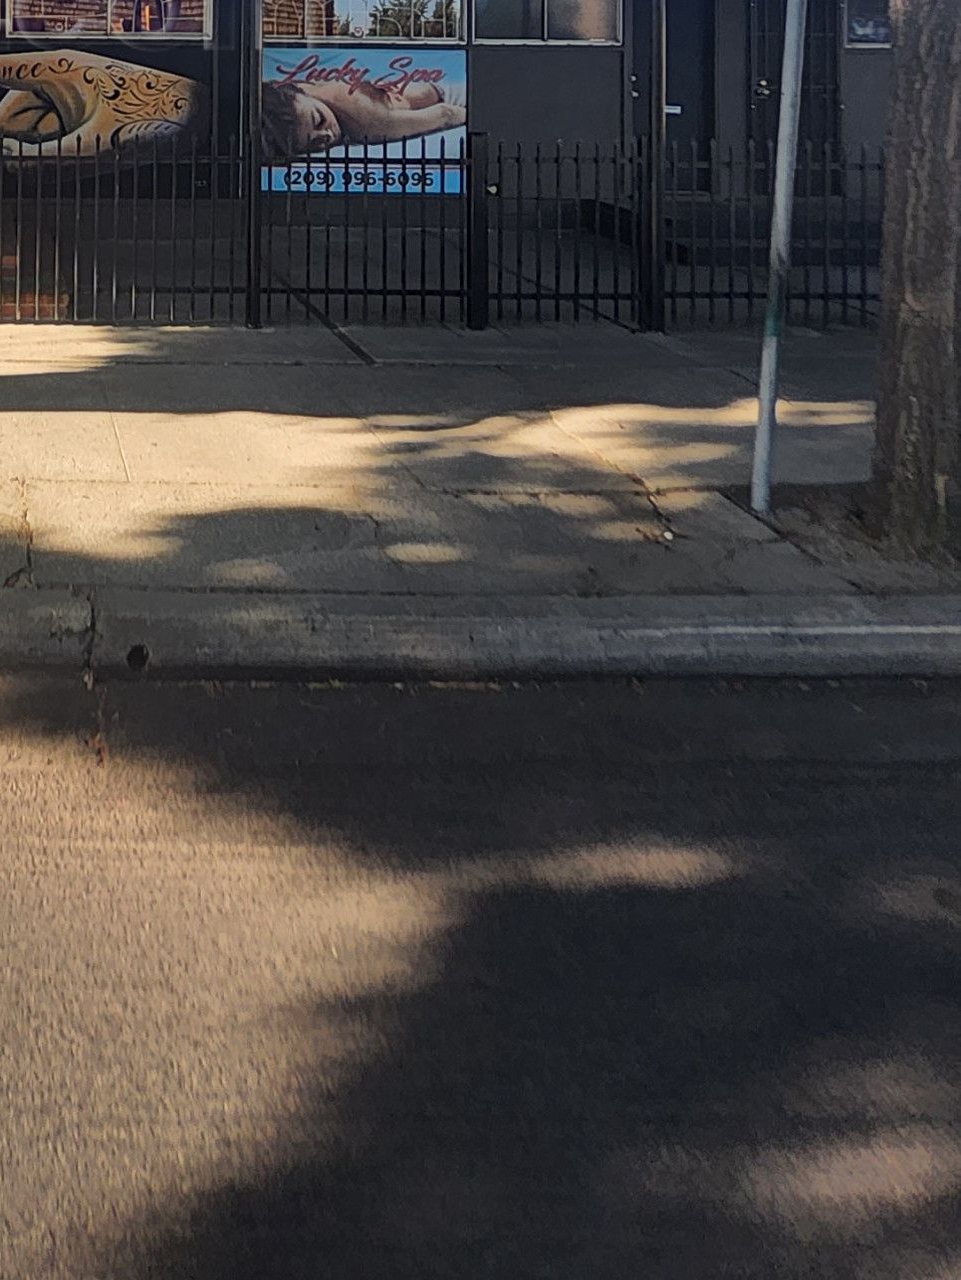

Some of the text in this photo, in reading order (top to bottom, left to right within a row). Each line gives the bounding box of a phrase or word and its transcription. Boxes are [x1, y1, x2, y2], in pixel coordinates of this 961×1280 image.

[273, 54, 446, 96] Lucky Spa
[283, 170, 435, 189] (209) 996-6096
